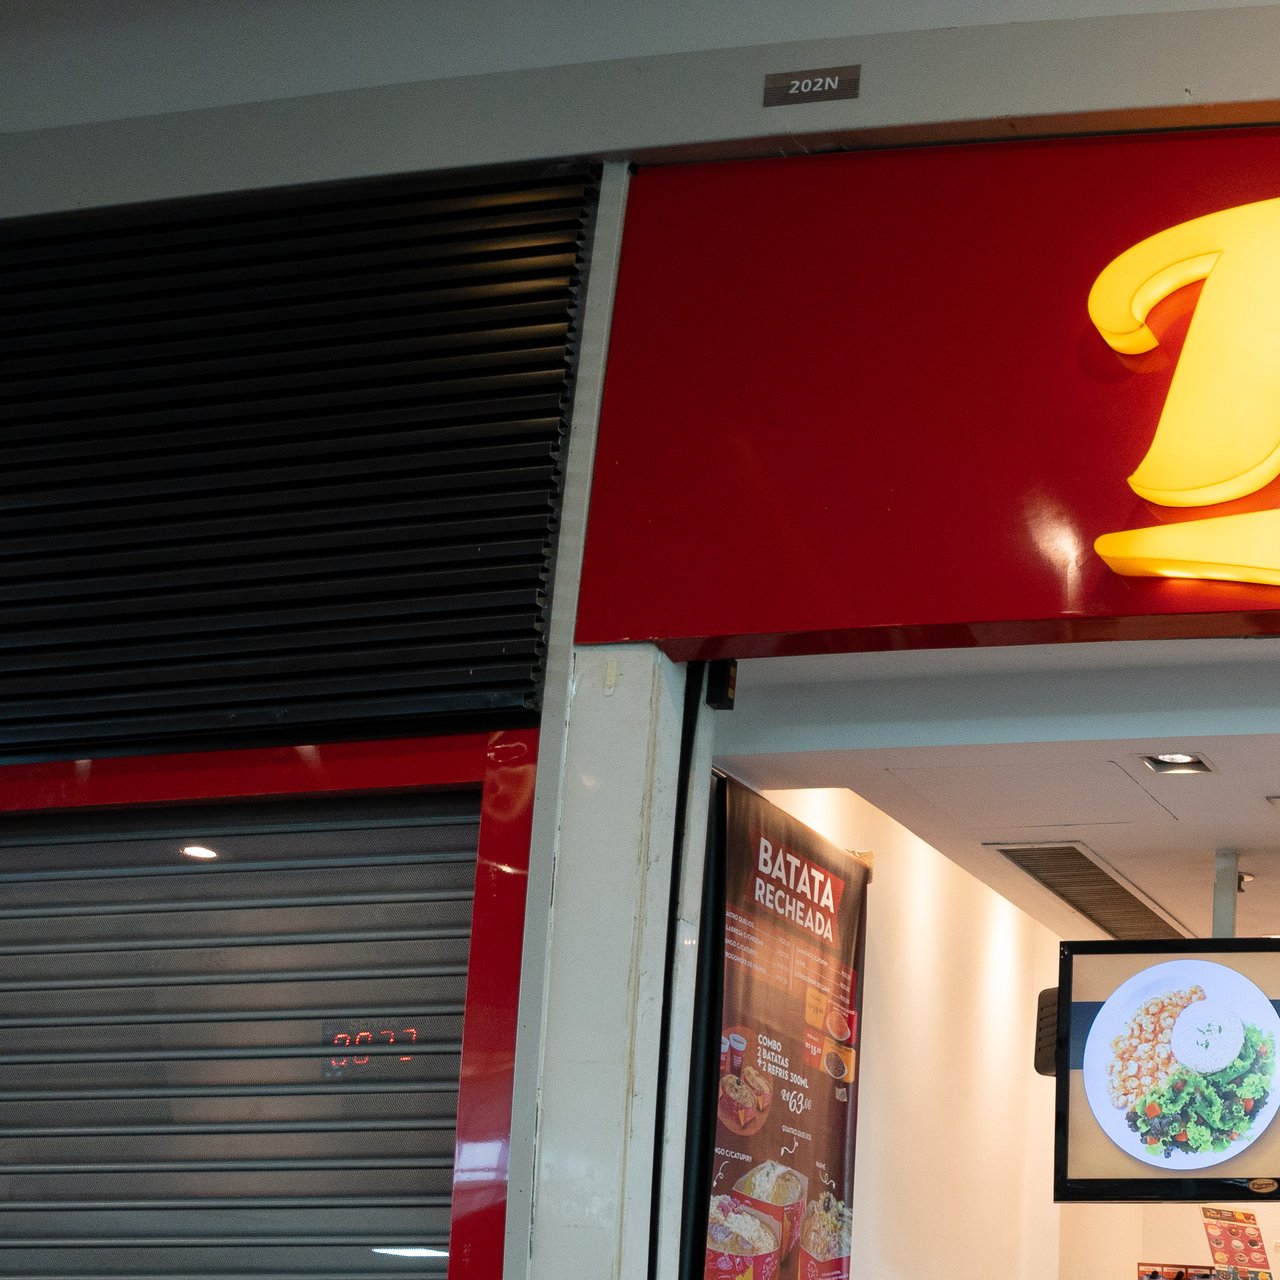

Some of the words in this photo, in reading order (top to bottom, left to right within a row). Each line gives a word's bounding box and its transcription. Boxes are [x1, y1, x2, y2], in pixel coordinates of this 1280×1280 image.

[789, 76, 839, 94] 202N
[758, 837, 835, 913] BATATA
[754, 876, 834, 942] RECHEADA
[758, 1034, 782, 1051] COMBO
[762, 1049, 789, 1068] BATATAS
[767, 1064, 789, 1081] REFRIS
[790, 1071, 809, 1089] 300ML
